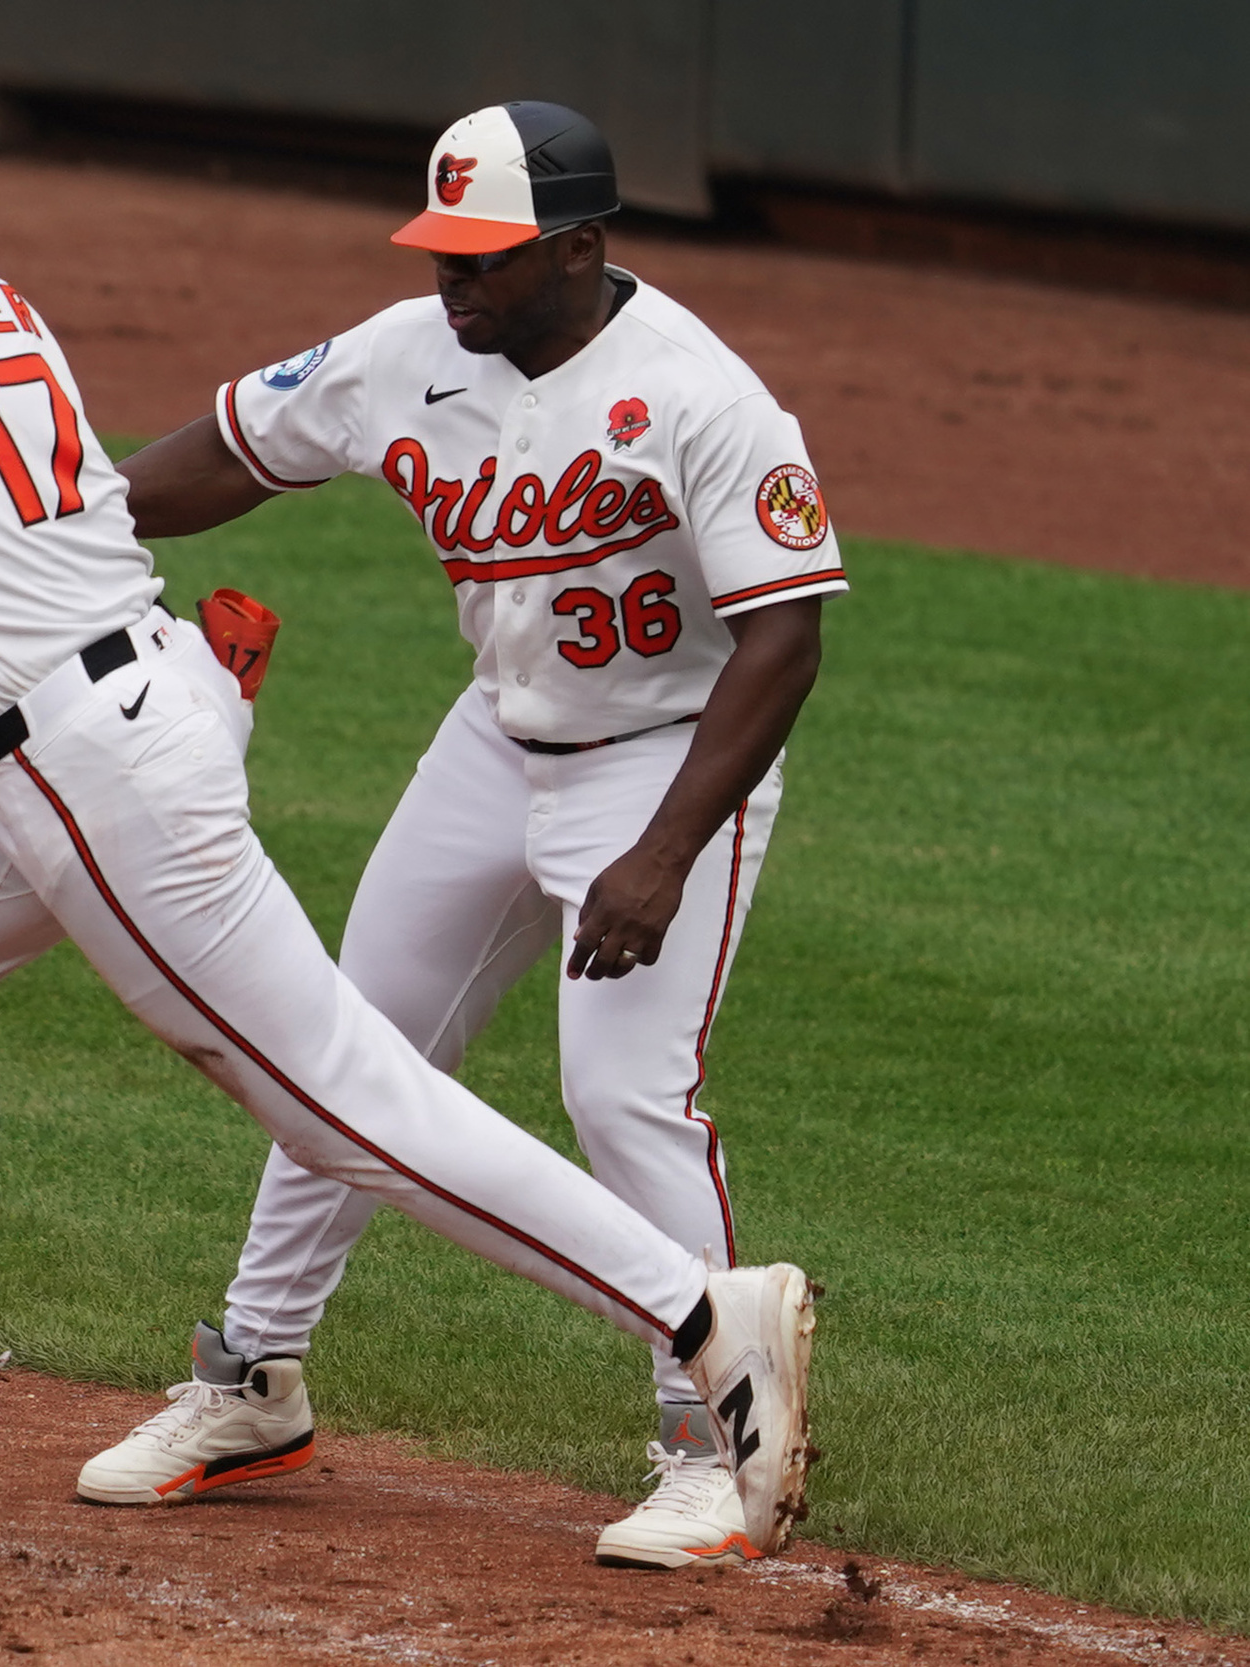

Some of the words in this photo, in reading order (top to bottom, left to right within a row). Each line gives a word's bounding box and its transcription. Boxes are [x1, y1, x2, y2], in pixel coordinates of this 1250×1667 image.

[381, 436, 679, 553] Orioles
[760, 466, 818, 501] BALTIMORE
[551, 568, 682, 669] 36
[228, 642, 261, 678] 17
